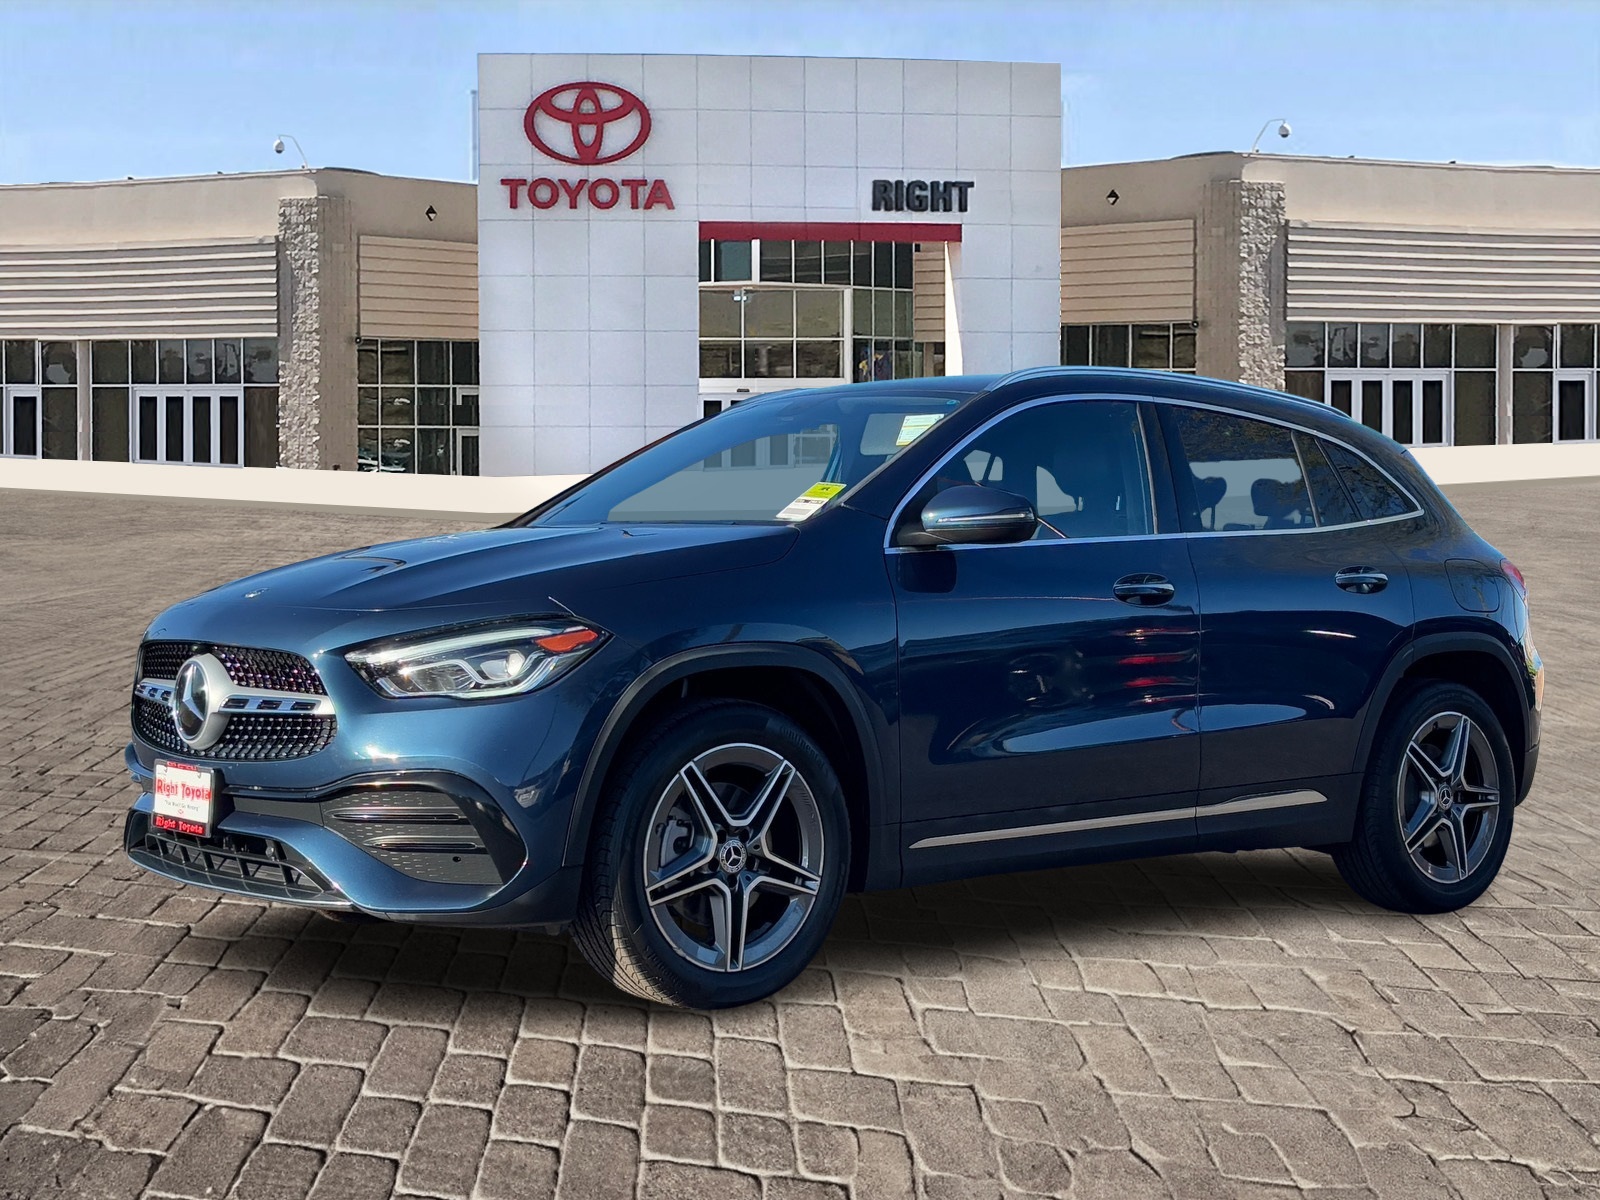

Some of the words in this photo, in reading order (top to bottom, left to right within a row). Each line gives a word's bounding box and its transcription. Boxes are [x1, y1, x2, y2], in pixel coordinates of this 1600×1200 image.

[500, 178, 675, 210] TOYOTA
[872, 180, 975, 213] RIGHT
[156, 778, 178, 797] Right
[181, 783, 212, 801] Toyota
[156, 816, 176, 829] Right
[178, 821, 203, 834] Toyota
